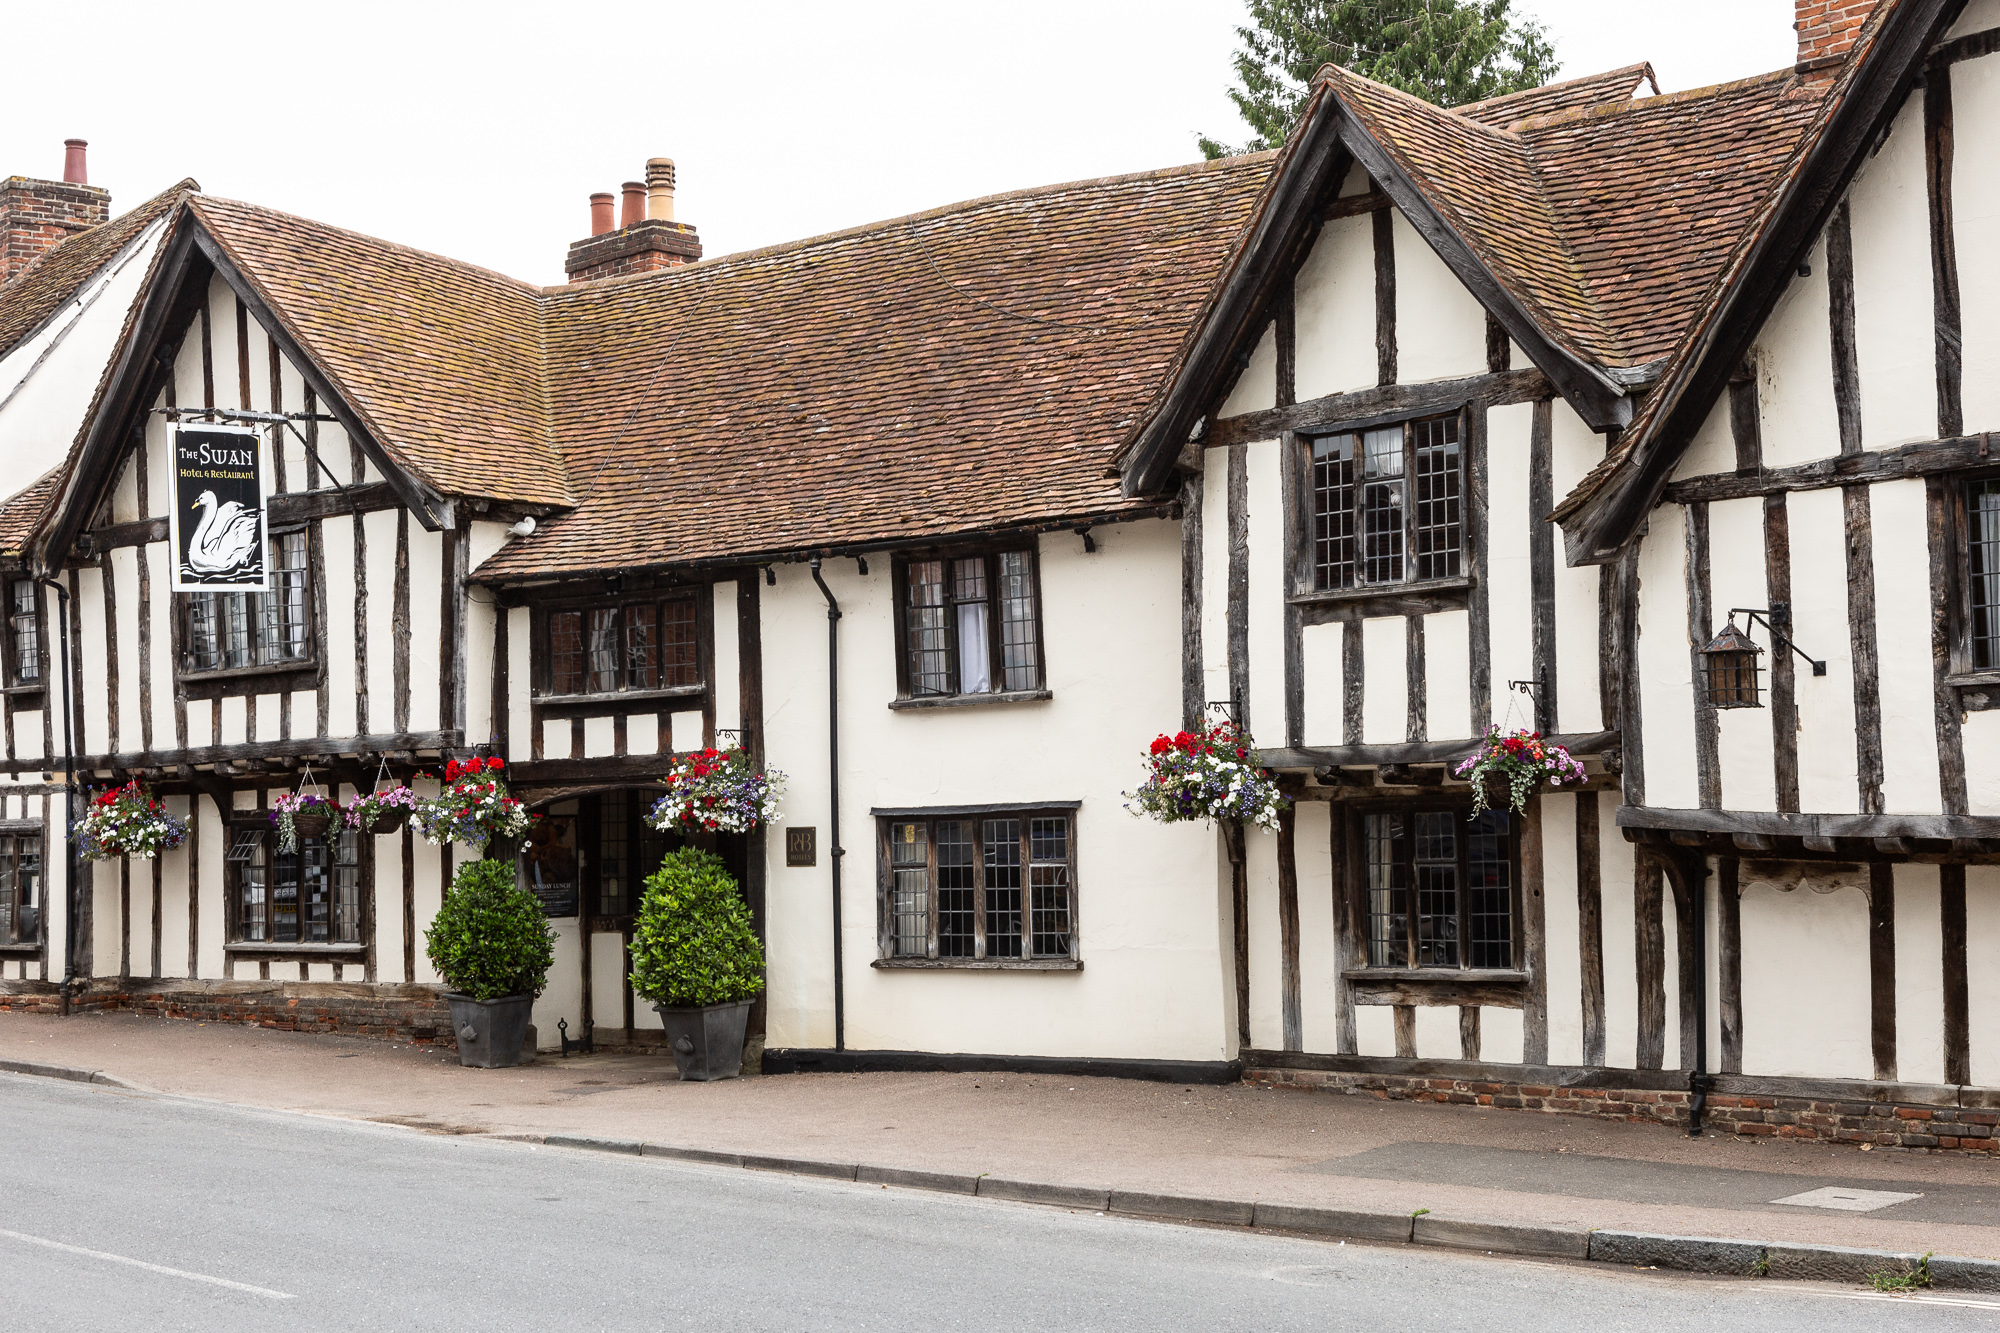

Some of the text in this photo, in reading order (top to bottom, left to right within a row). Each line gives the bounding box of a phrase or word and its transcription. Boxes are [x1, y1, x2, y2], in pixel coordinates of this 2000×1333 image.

[179, 442, 253, 466] THE SWAN
[204, 470, 210, 479] &
